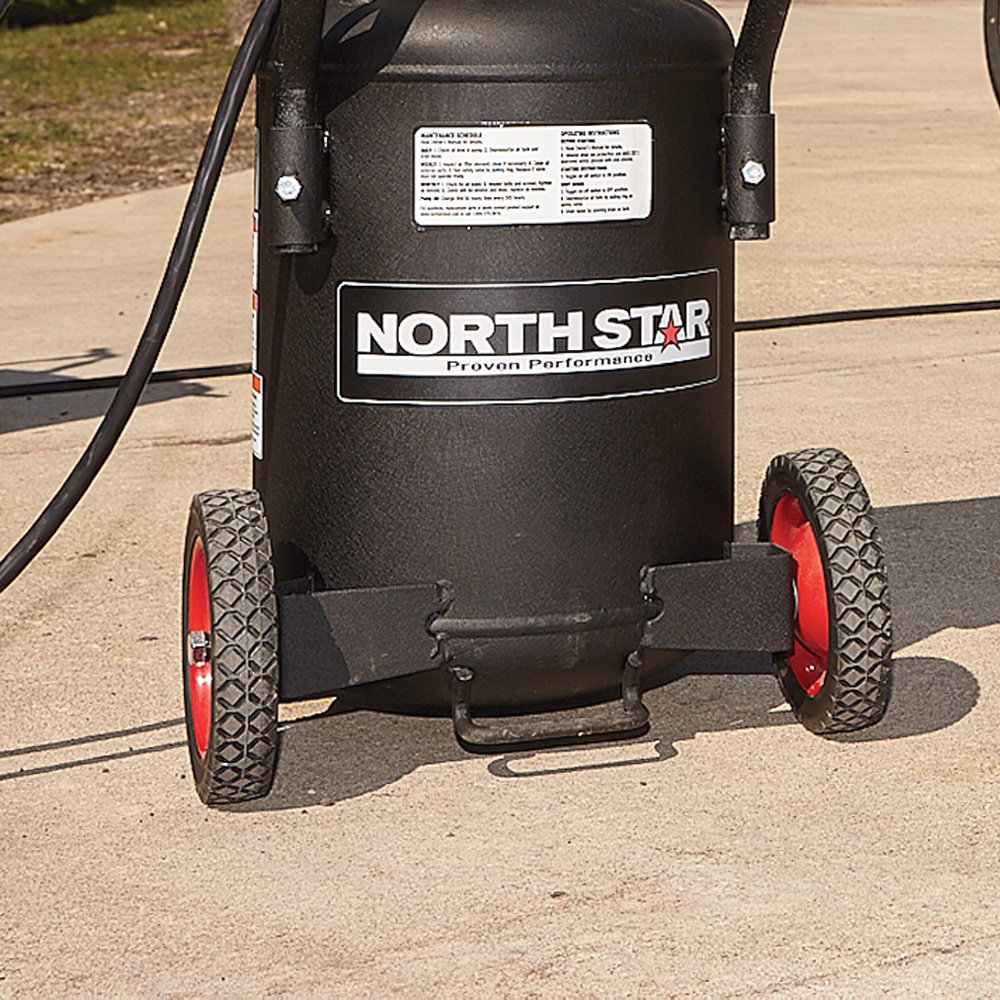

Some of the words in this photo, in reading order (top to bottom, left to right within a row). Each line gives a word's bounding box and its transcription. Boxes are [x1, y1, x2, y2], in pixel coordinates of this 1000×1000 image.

[357, 311, 584, 355] NORTH
[593, 299, 711, 349] STAR
[447, 360, 520, 372] Proven
[529, 353, 653, 370] Performance
